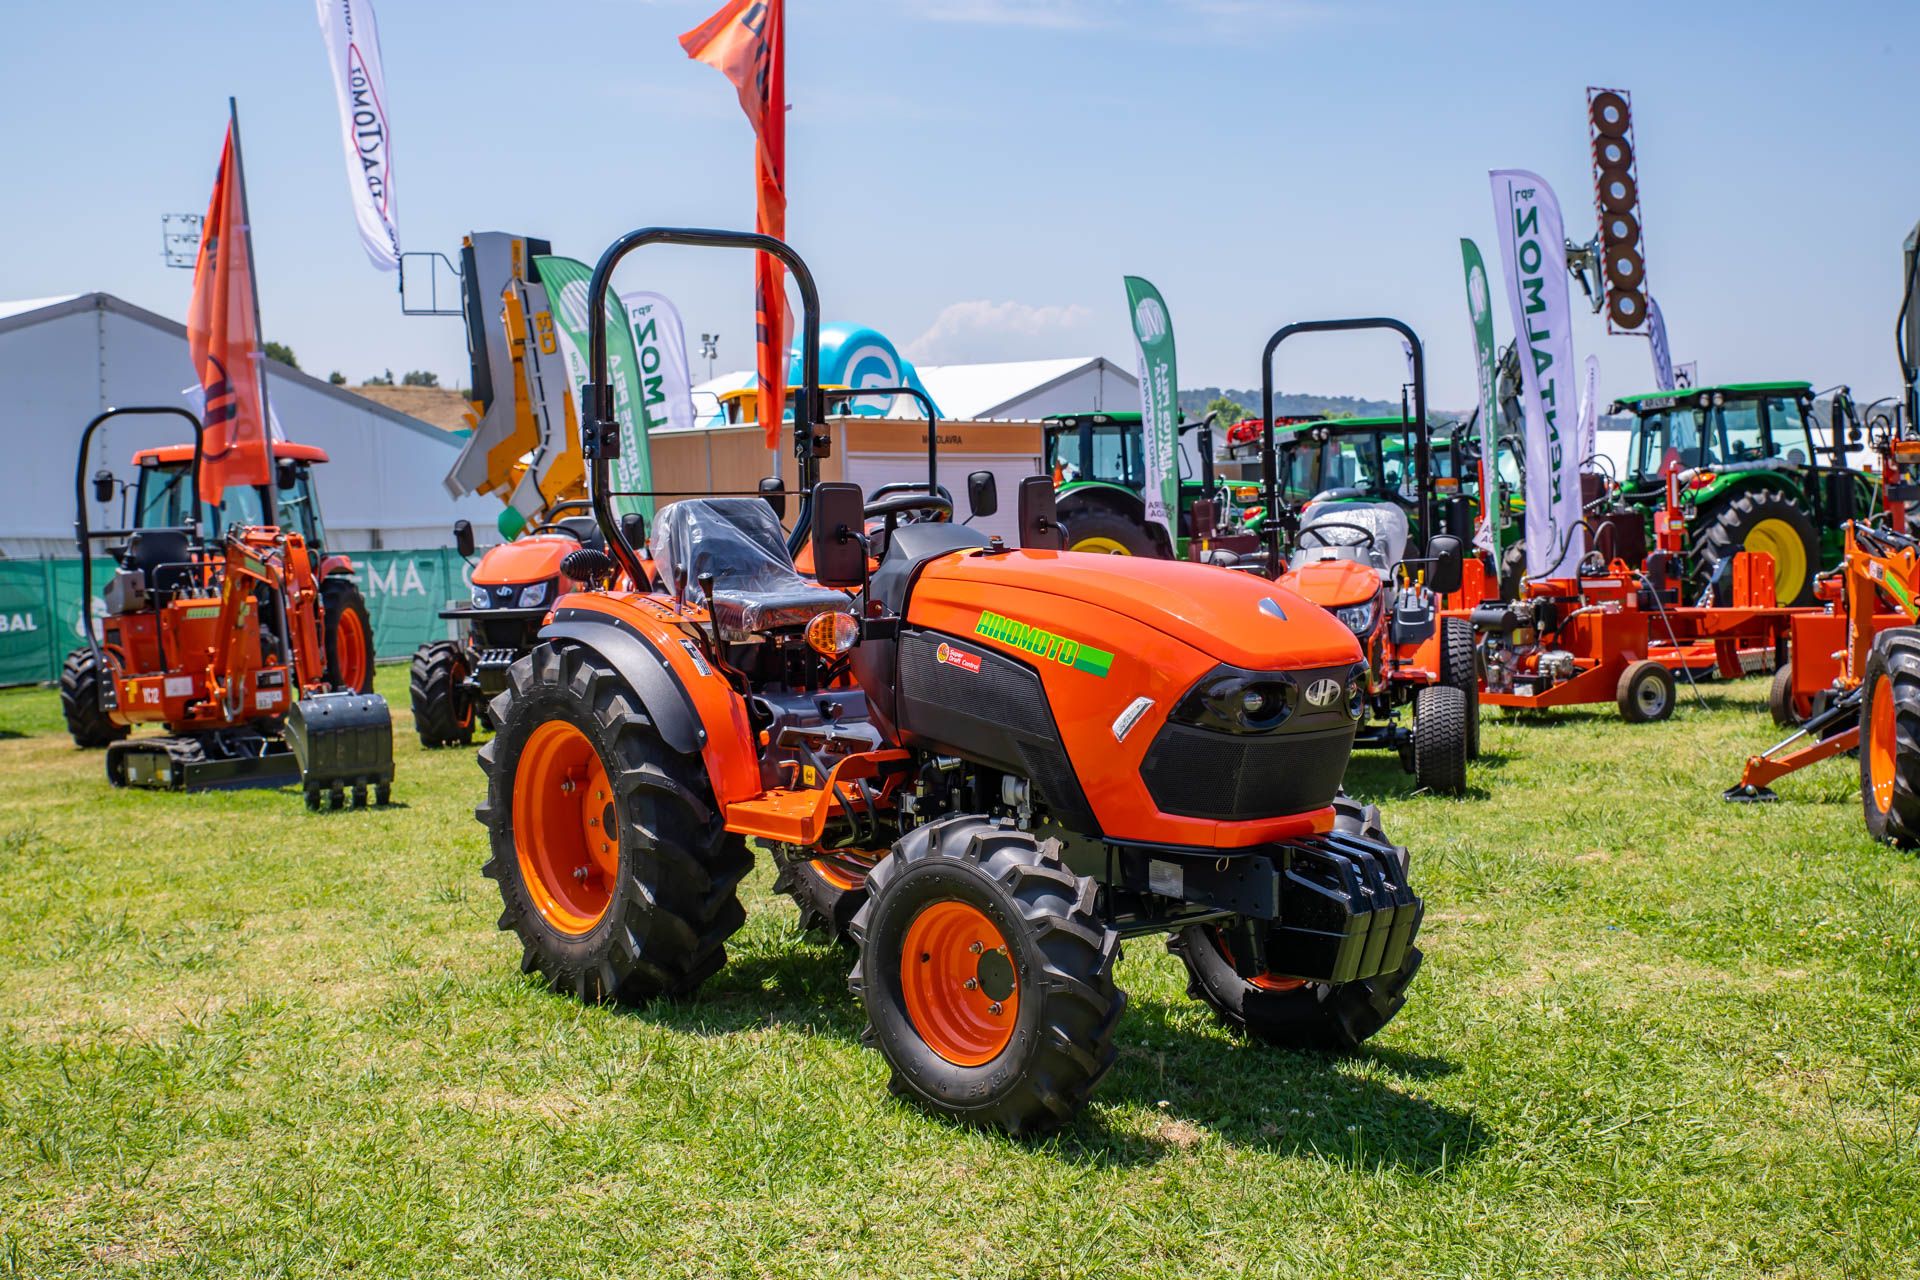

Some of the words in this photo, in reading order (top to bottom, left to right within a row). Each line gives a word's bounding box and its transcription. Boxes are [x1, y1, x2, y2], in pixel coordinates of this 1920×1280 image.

[975, 610, 1080, 667] HINOMOTO
[949, 649, 964, 658] Super
[948, 656, 961, 664] Draft
[961, 659, 979, 670] Control
